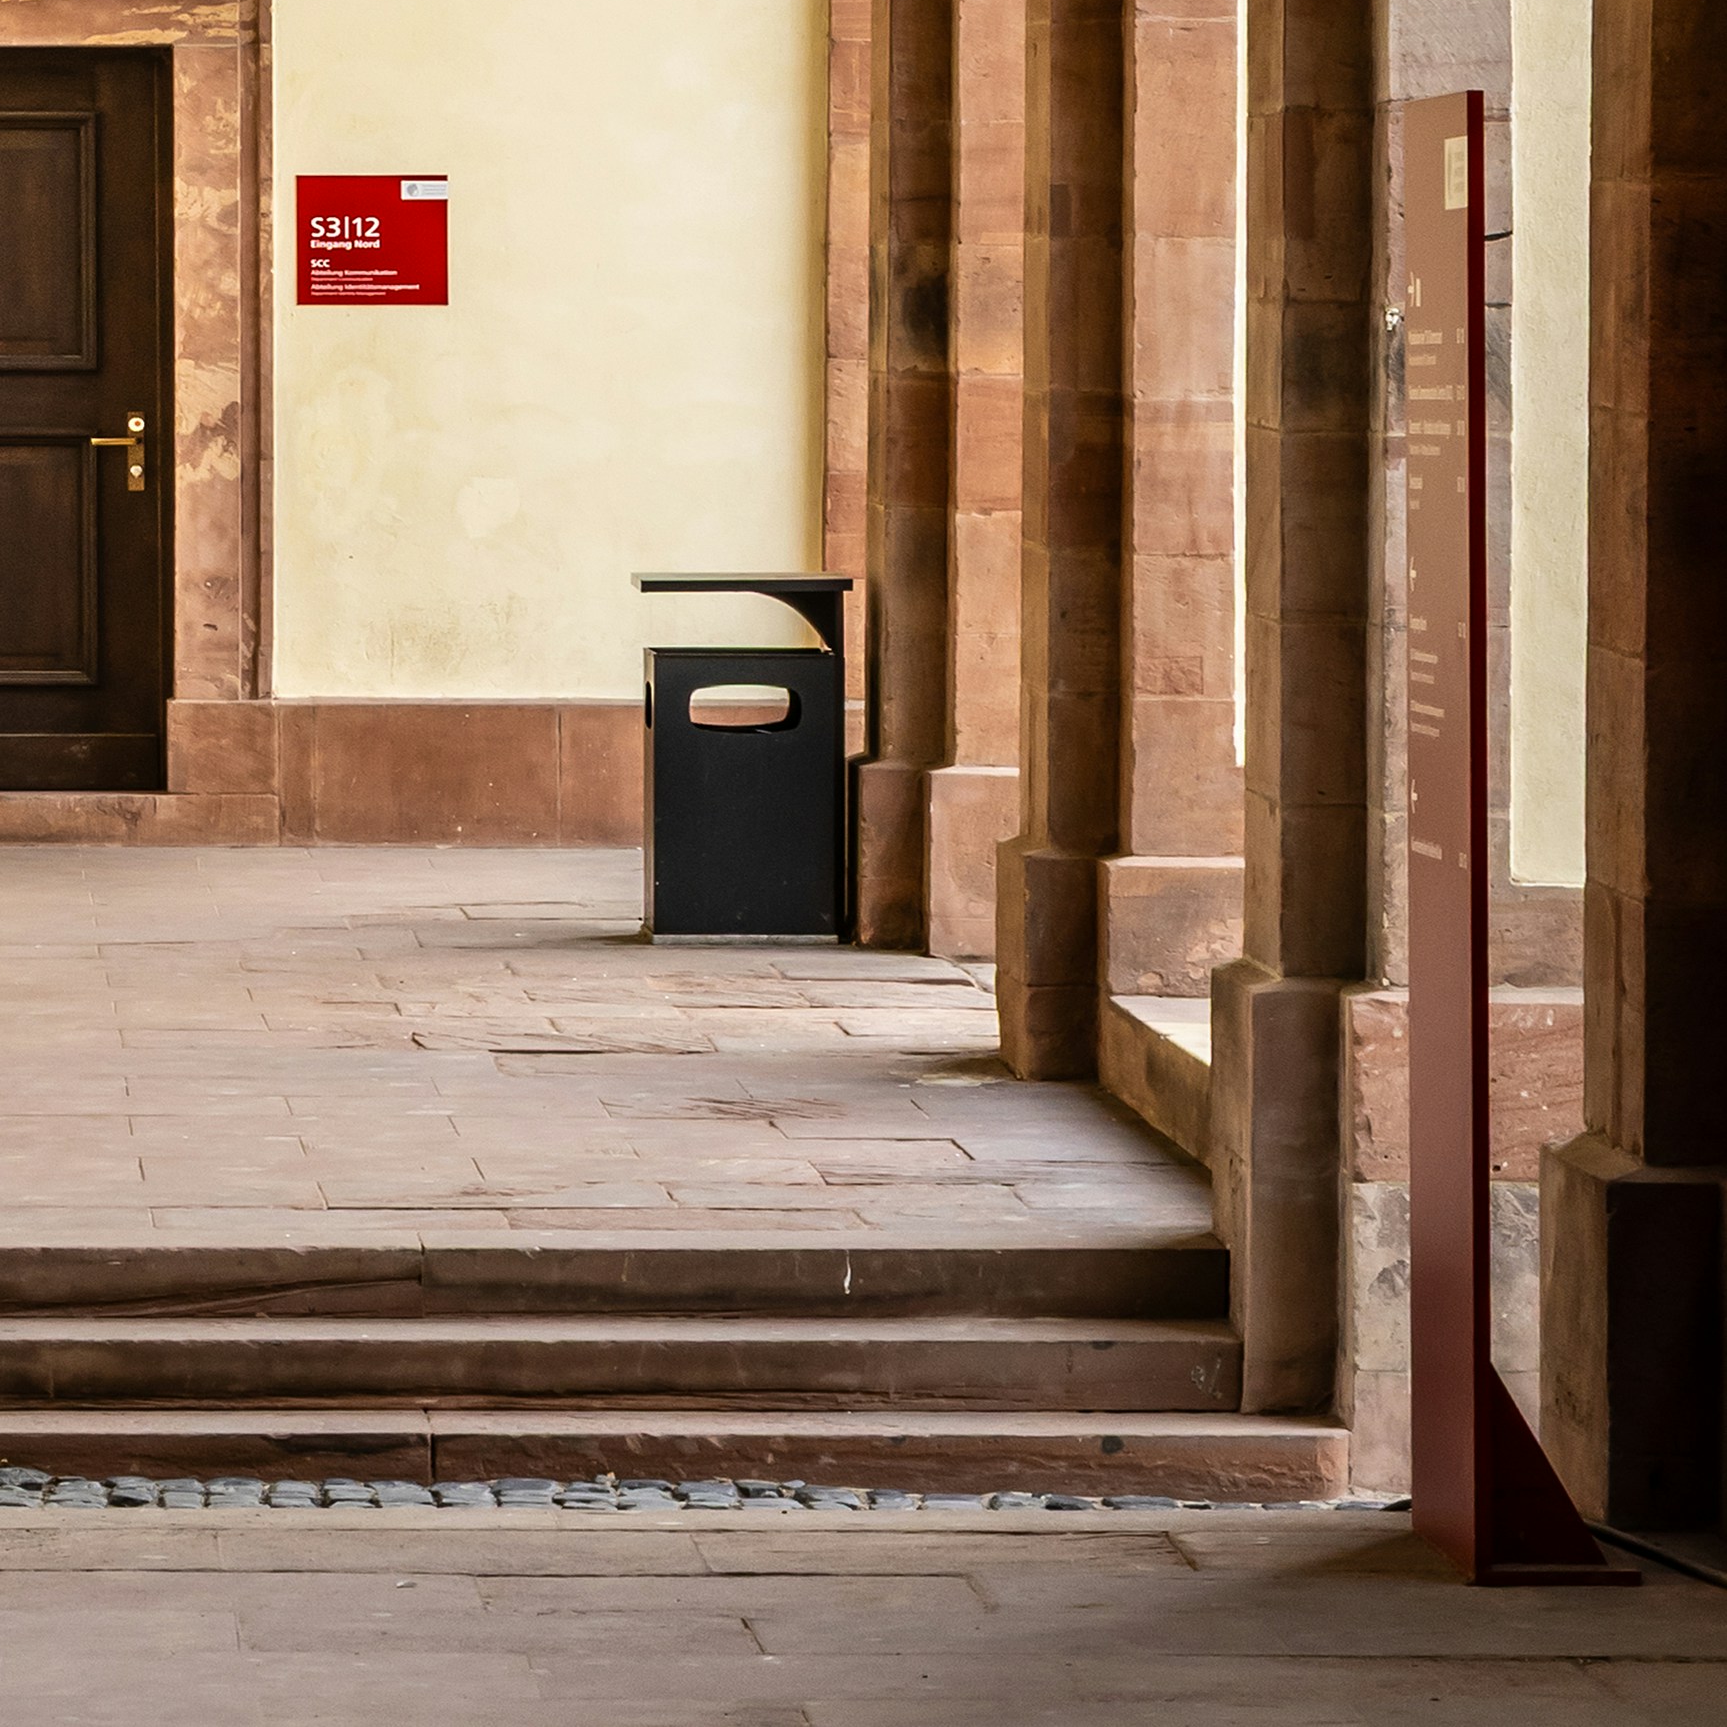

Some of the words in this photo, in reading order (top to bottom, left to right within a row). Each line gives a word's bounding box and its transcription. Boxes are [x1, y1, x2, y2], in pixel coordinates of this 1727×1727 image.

[310, 216, 380, 239] S3|12
[310, 239, 352, 250] Eingang
[354, 239, 380, 248] Nord
[310, 258, 330, 267] SCC
